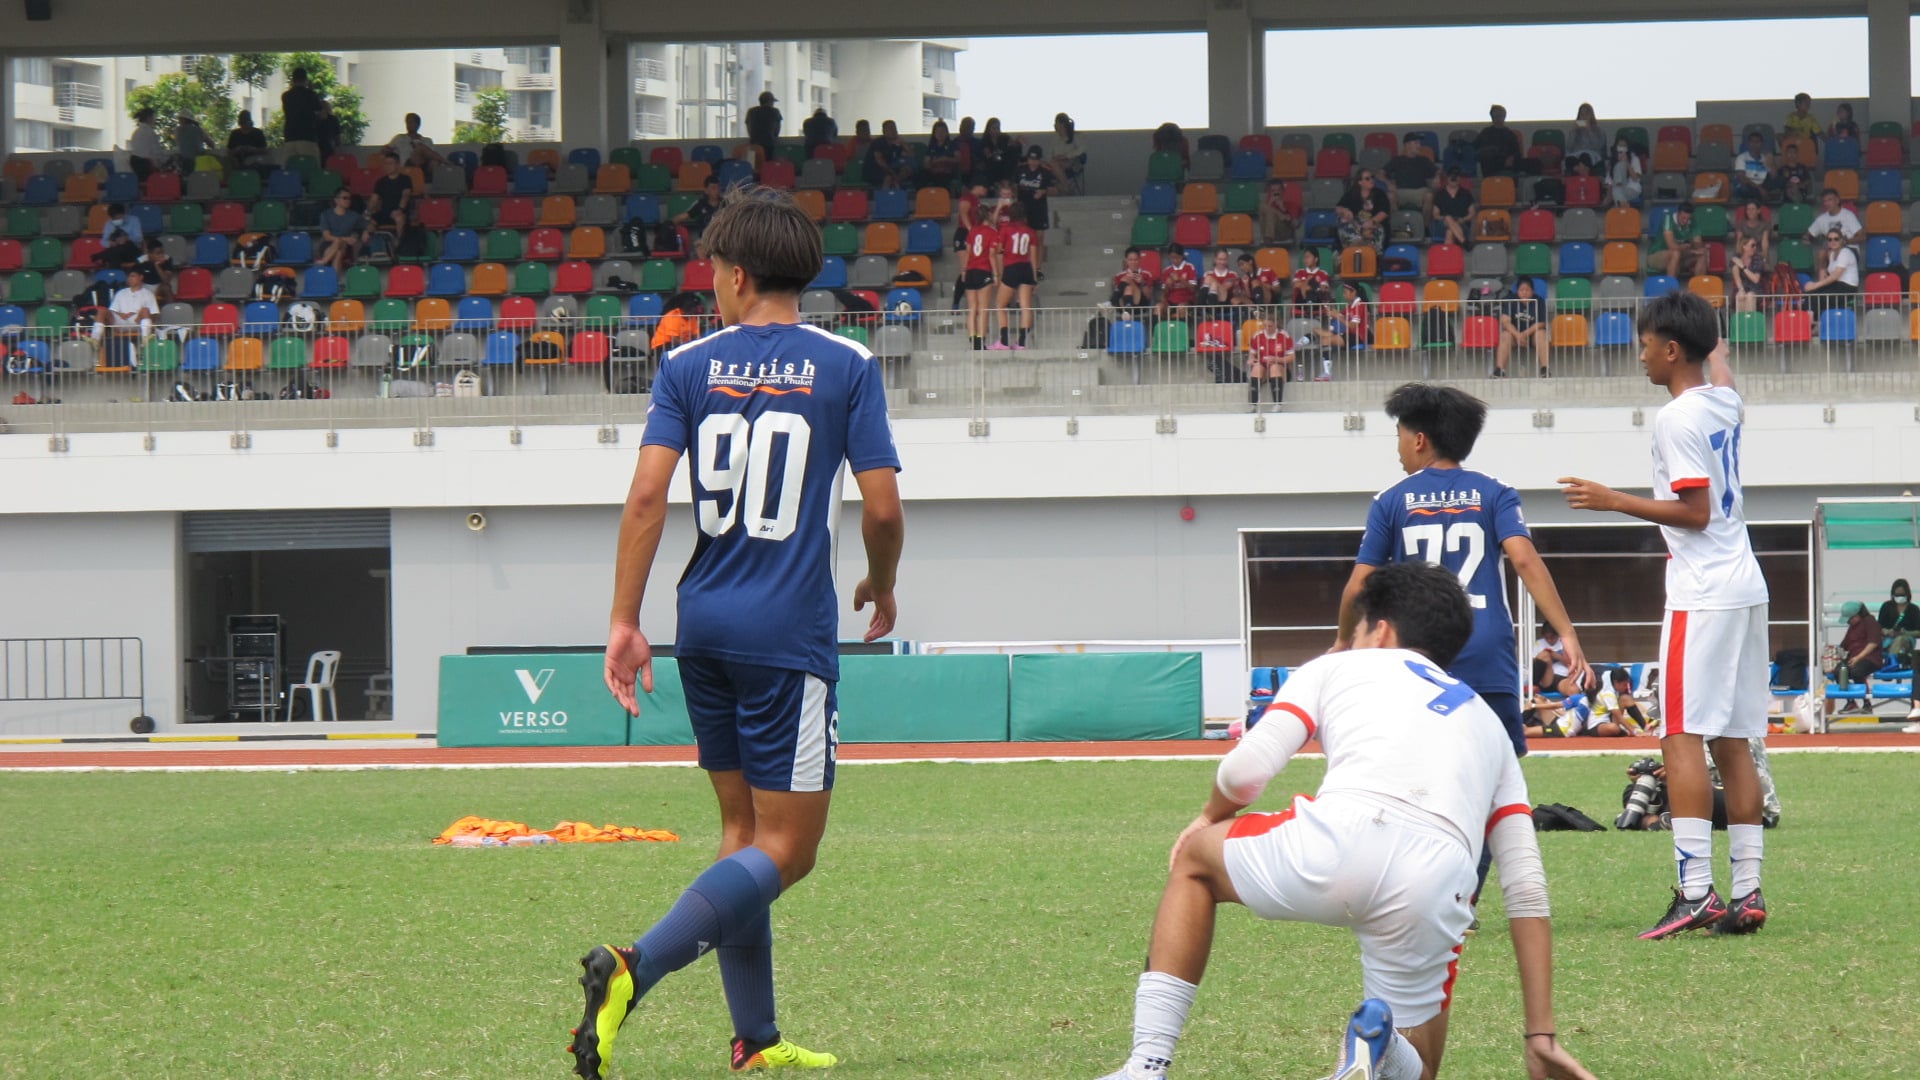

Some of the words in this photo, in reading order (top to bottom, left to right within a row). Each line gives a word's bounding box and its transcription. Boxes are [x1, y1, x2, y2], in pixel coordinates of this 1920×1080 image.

[973, 234, 983, 257] 8
[1011, 232, 1030, 256] 10
[708, 358, 816, 377] British
[784, 376, 813, 386] Phuket
[698, 411, 811, 541] 90
[1404, 488, 1481, 504] British
[760, 524, 775, 533] Ari
[1402, 522, 1487, 609] 72
[499, 710, 568, 727] VERSO
